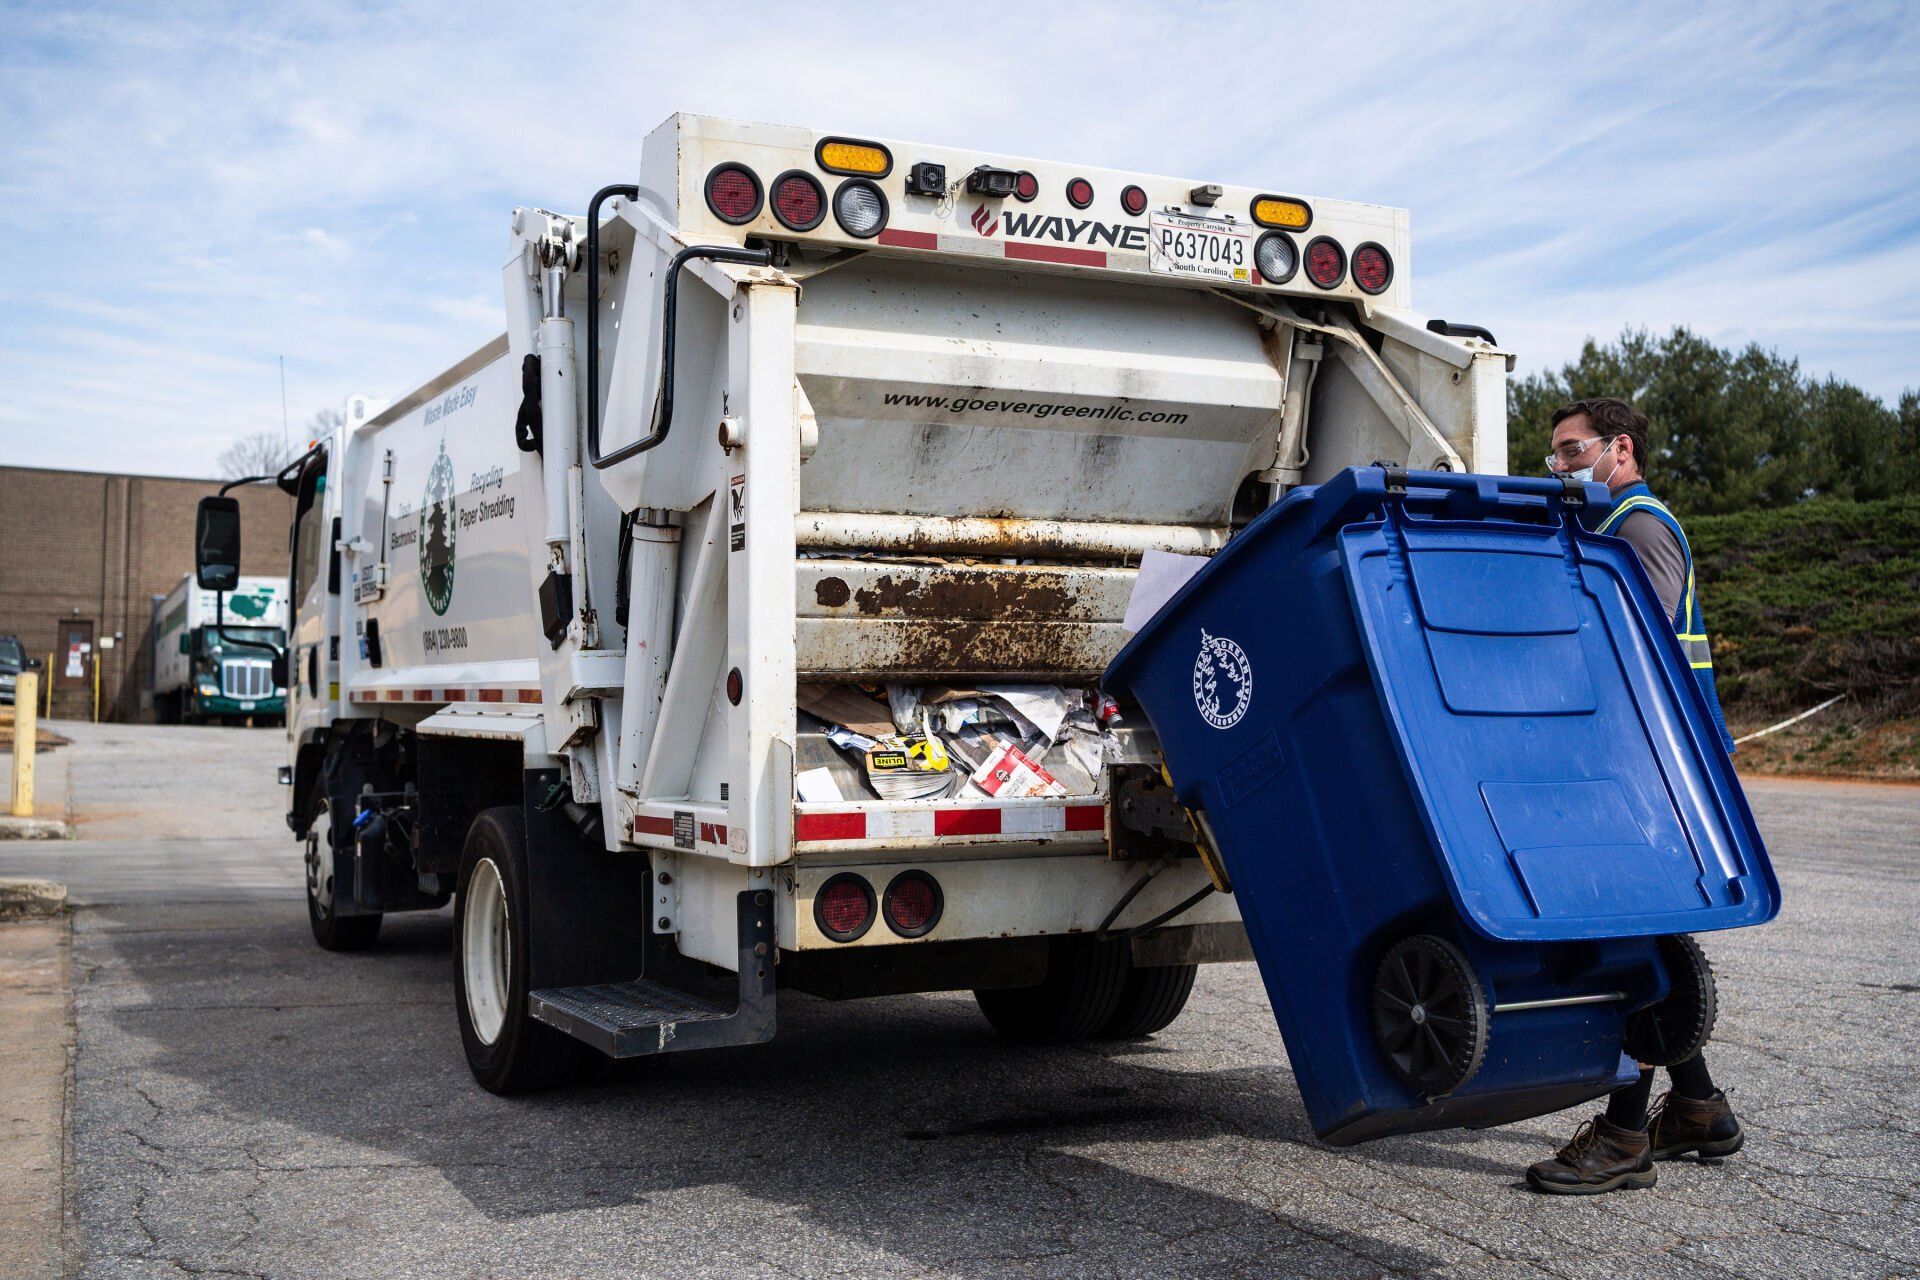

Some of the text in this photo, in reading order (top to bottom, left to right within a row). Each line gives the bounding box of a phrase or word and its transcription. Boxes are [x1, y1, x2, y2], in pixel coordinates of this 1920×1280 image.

[1002, 211, 1150, 251] WAYNE
[1178, 217, 1226, 232] Property Carrying
[1162, 229, 1243, 266] P637043
[1174, 261, 1228, 276] South Carolina
[423, 384, 478, 428] Waste Made Easy
[884, 392, 1189, 425] www.goevergreenllc.com
[469, 465, 504, 495] Recycling
[459, 493, 515, 531] Paper Shredding
